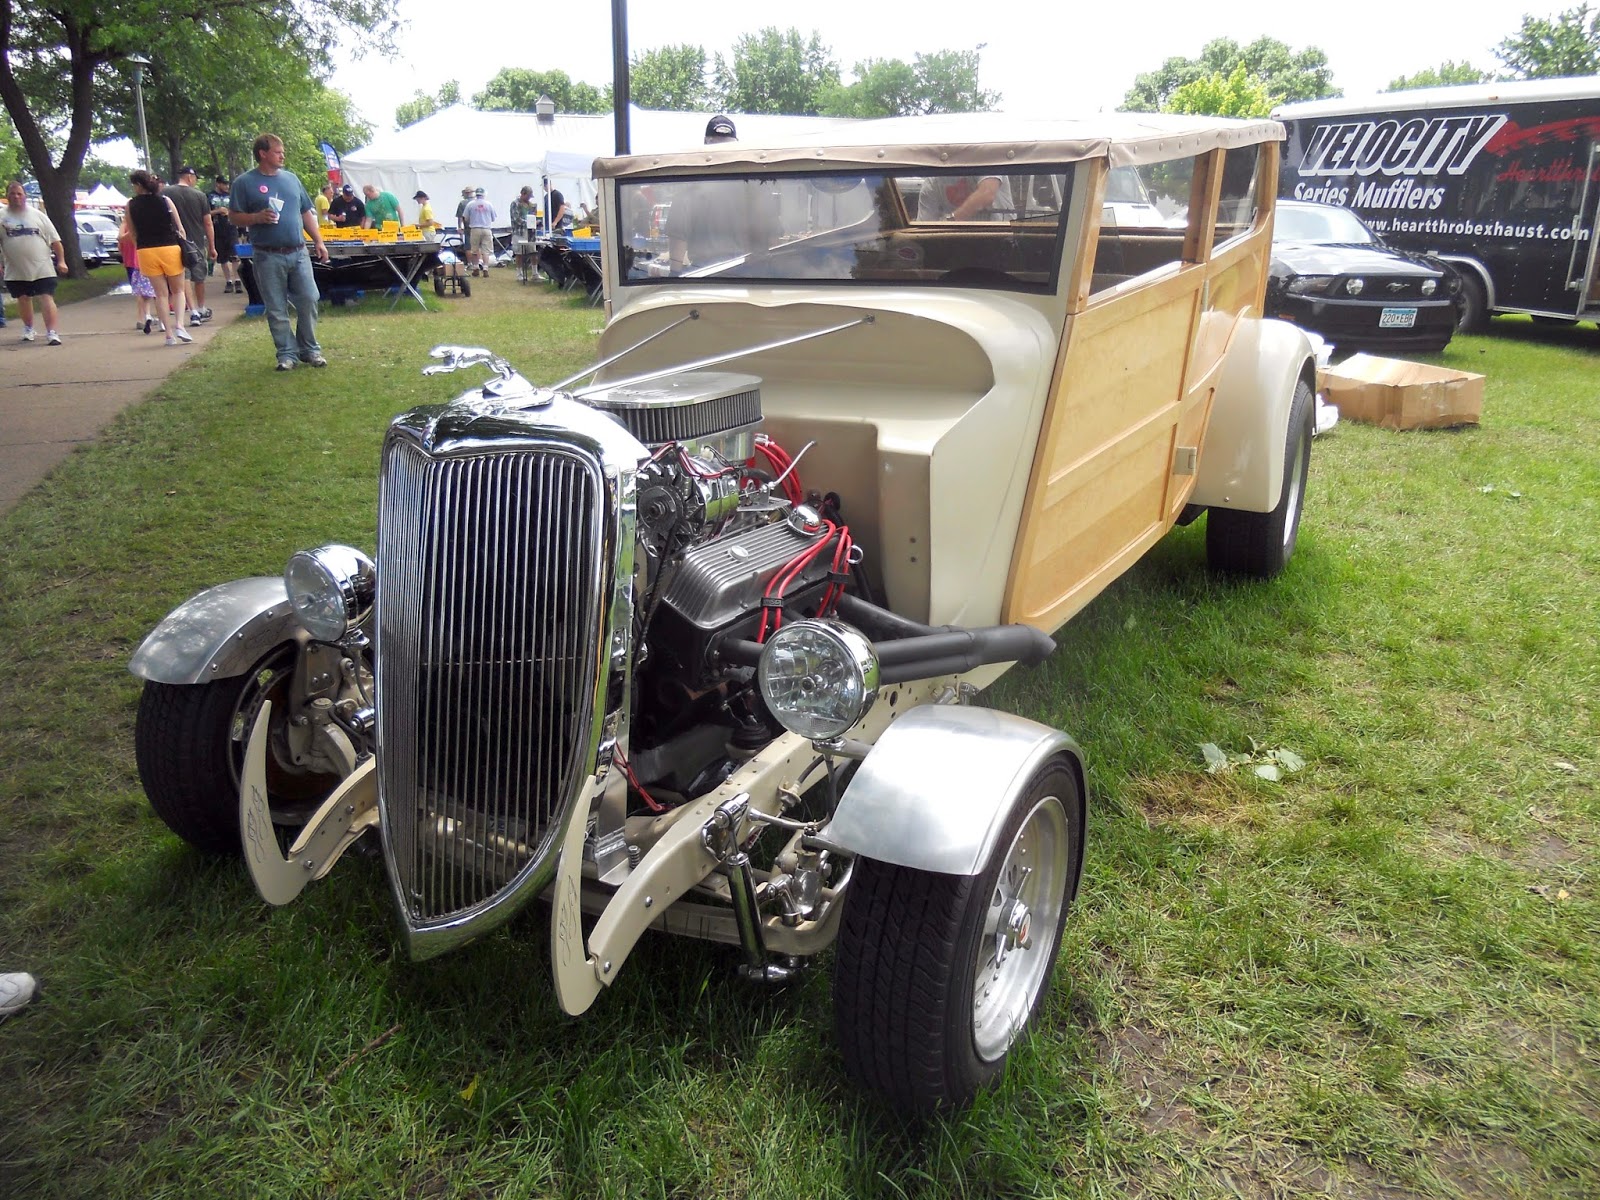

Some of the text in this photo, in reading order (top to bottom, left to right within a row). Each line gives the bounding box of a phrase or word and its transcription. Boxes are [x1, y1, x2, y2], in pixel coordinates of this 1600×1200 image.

[1298, 114, 1508, 177] VELOCITY
[1294, 178, 1445, 210] Series Mufflers
